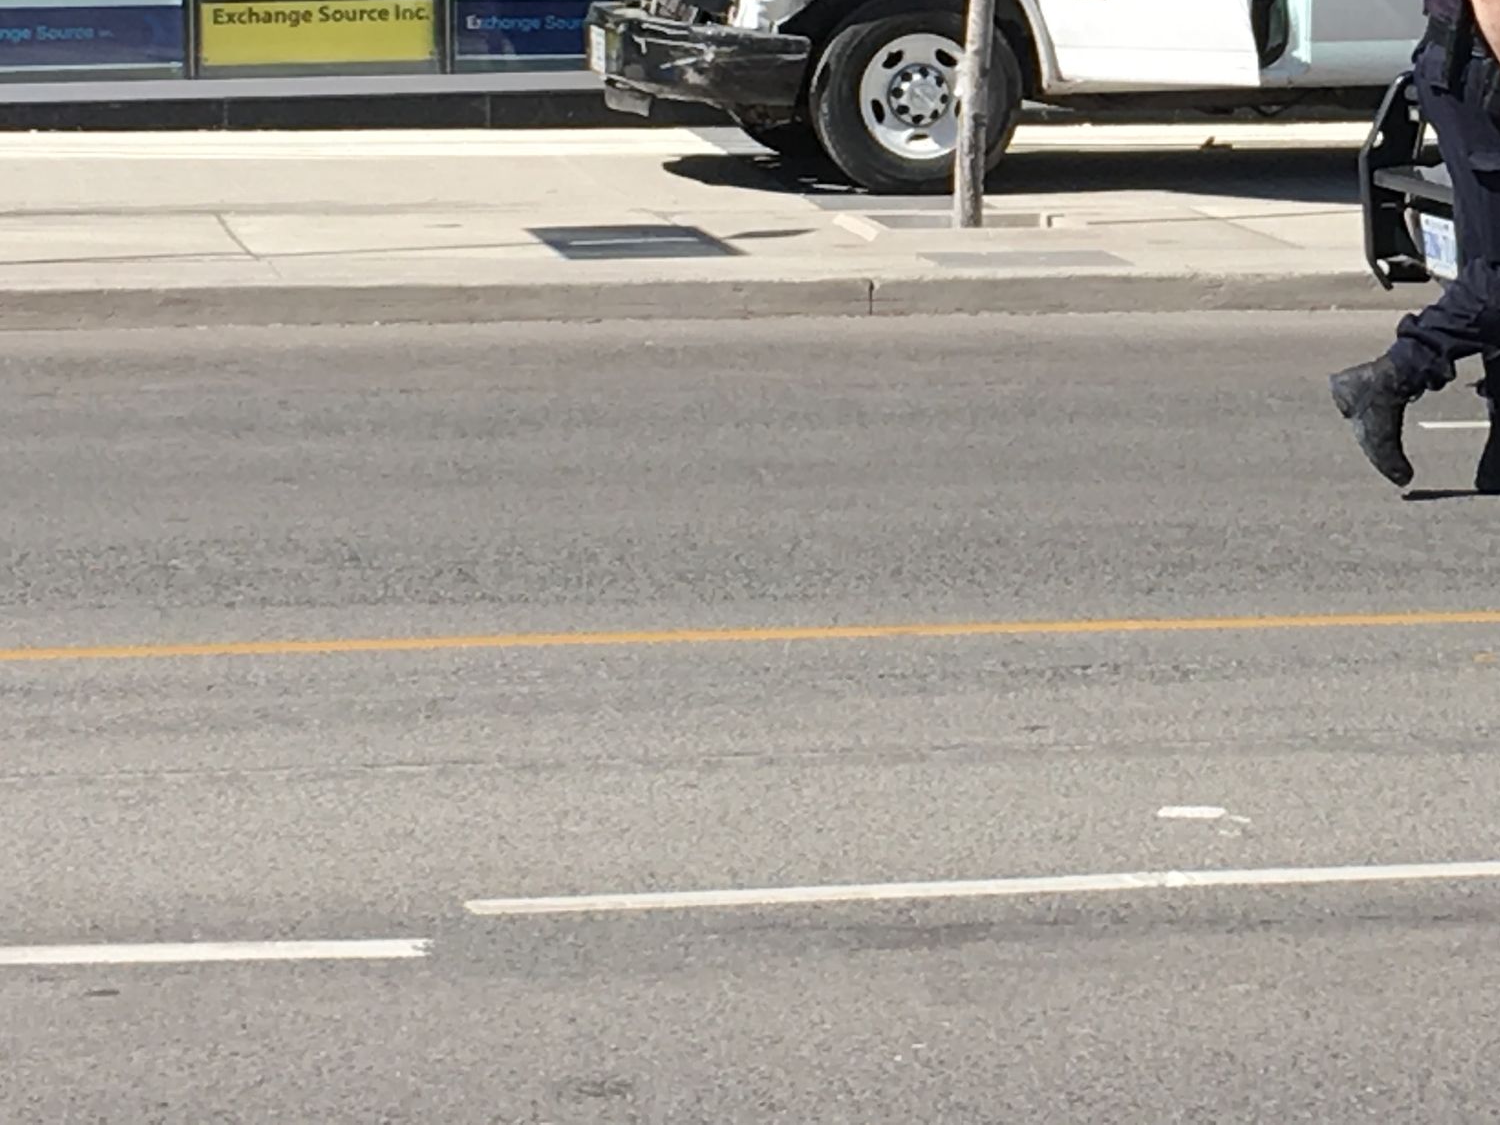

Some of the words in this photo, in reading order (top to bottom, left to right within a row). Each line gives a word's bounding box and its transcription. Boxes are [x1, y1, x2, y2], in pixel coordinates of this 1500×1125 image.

[212, 7, 314, 27] Exchange
[318, 5, 390, 23] Source
[394, 4, 430, 21] Inc.
[466, 15, 541, 32] Exchange
